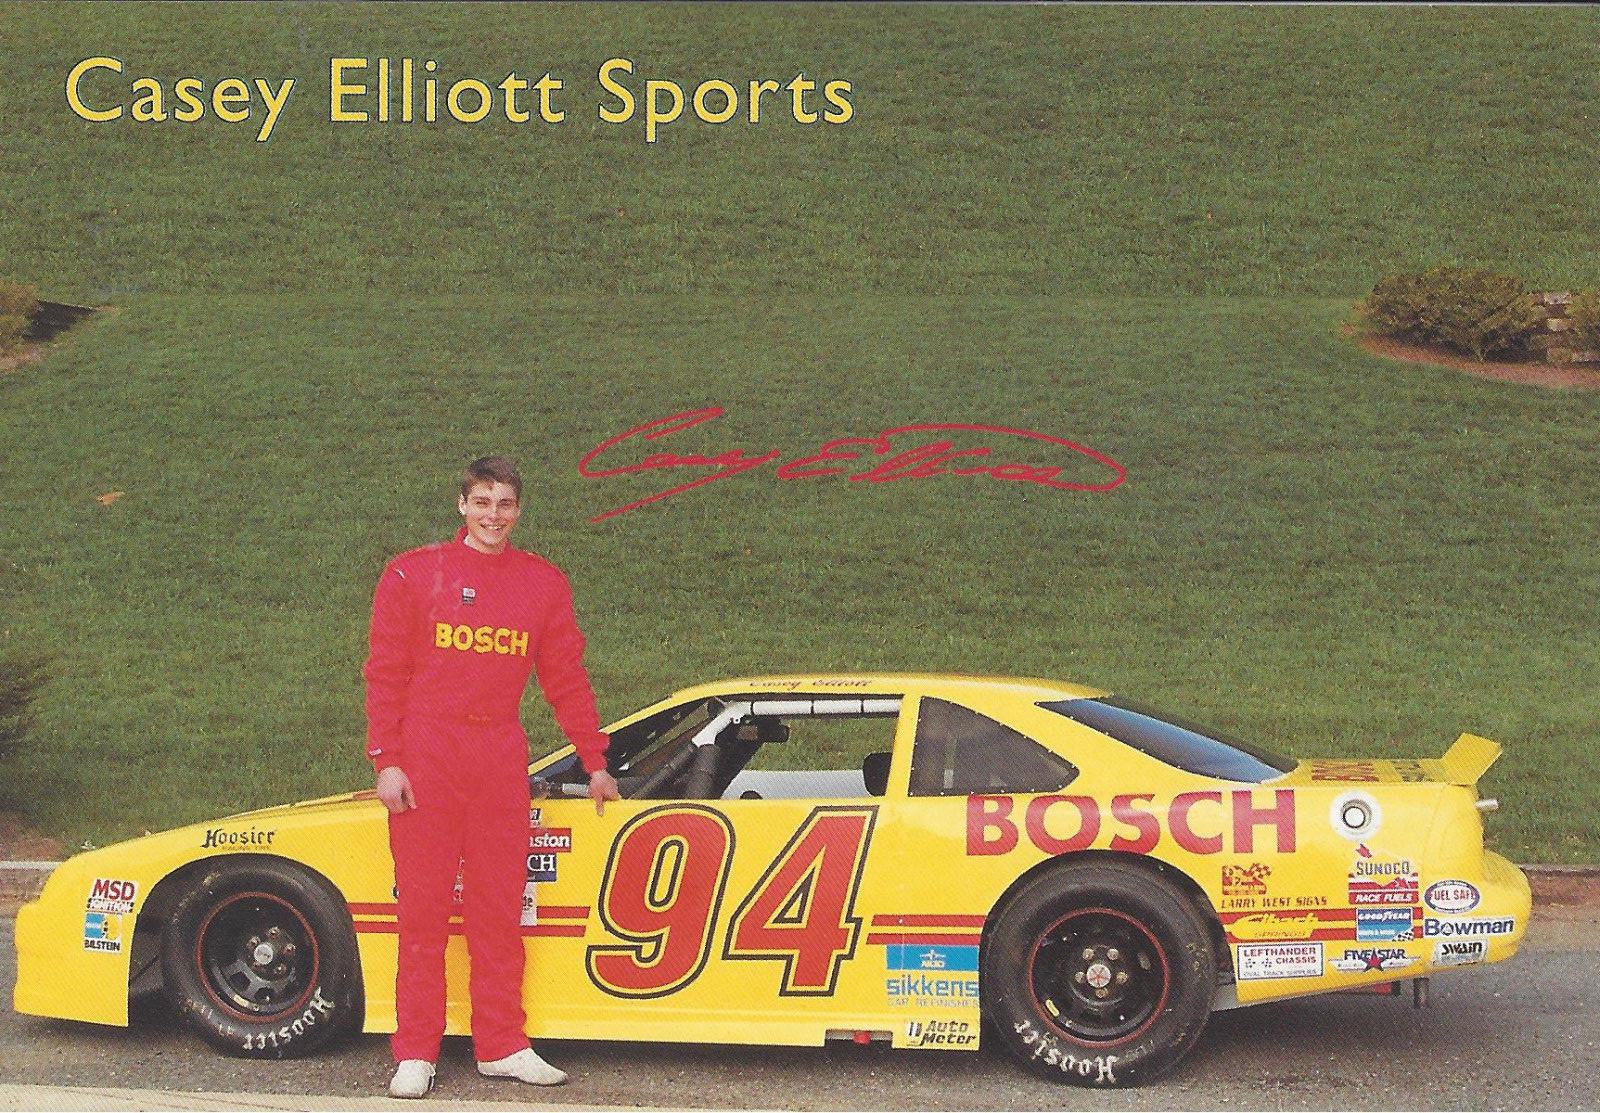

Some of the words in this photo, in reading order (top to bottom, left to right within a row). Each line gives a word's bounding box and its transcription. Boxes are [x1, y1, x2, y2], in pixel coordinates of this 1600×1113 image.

[435, 622, 529, 657] BOSCH
[966, 789, 1297, 857] BOSCH
[200, 826, 277, 848] Hoosier
[1356, 860, 1410, 876] SUNOCO
[91, 878, 136, 901] MSD
[1427, 889, 1451, 901] FUEL
[1453, 888, 1477, 901] SAFE
[584, 802, 880, 1000] 94
[1262, 897, 1291, 907] WEST
[1295, 895, 1328, 906] SIGNS
[1354, 893, 1382, 903] RACE
[1383, 892, 1413, 902] FUELS
[1424, 918, 1514, 937] Bowman
[84, 939, 121, 951] BILSTEIN
[1243, 946, 1317, 957] LEFTHANDER
[1275, 956, 1317, 965] CHASSIS
[1344, 949, 1372, 961] FIVE
[1377, 948, 1407, 960] STAR
[886, 973, 979, 998] sikkens
[925, 1020, 969, 1033] Auto
[918, 1032, 977, 1047] Meter
